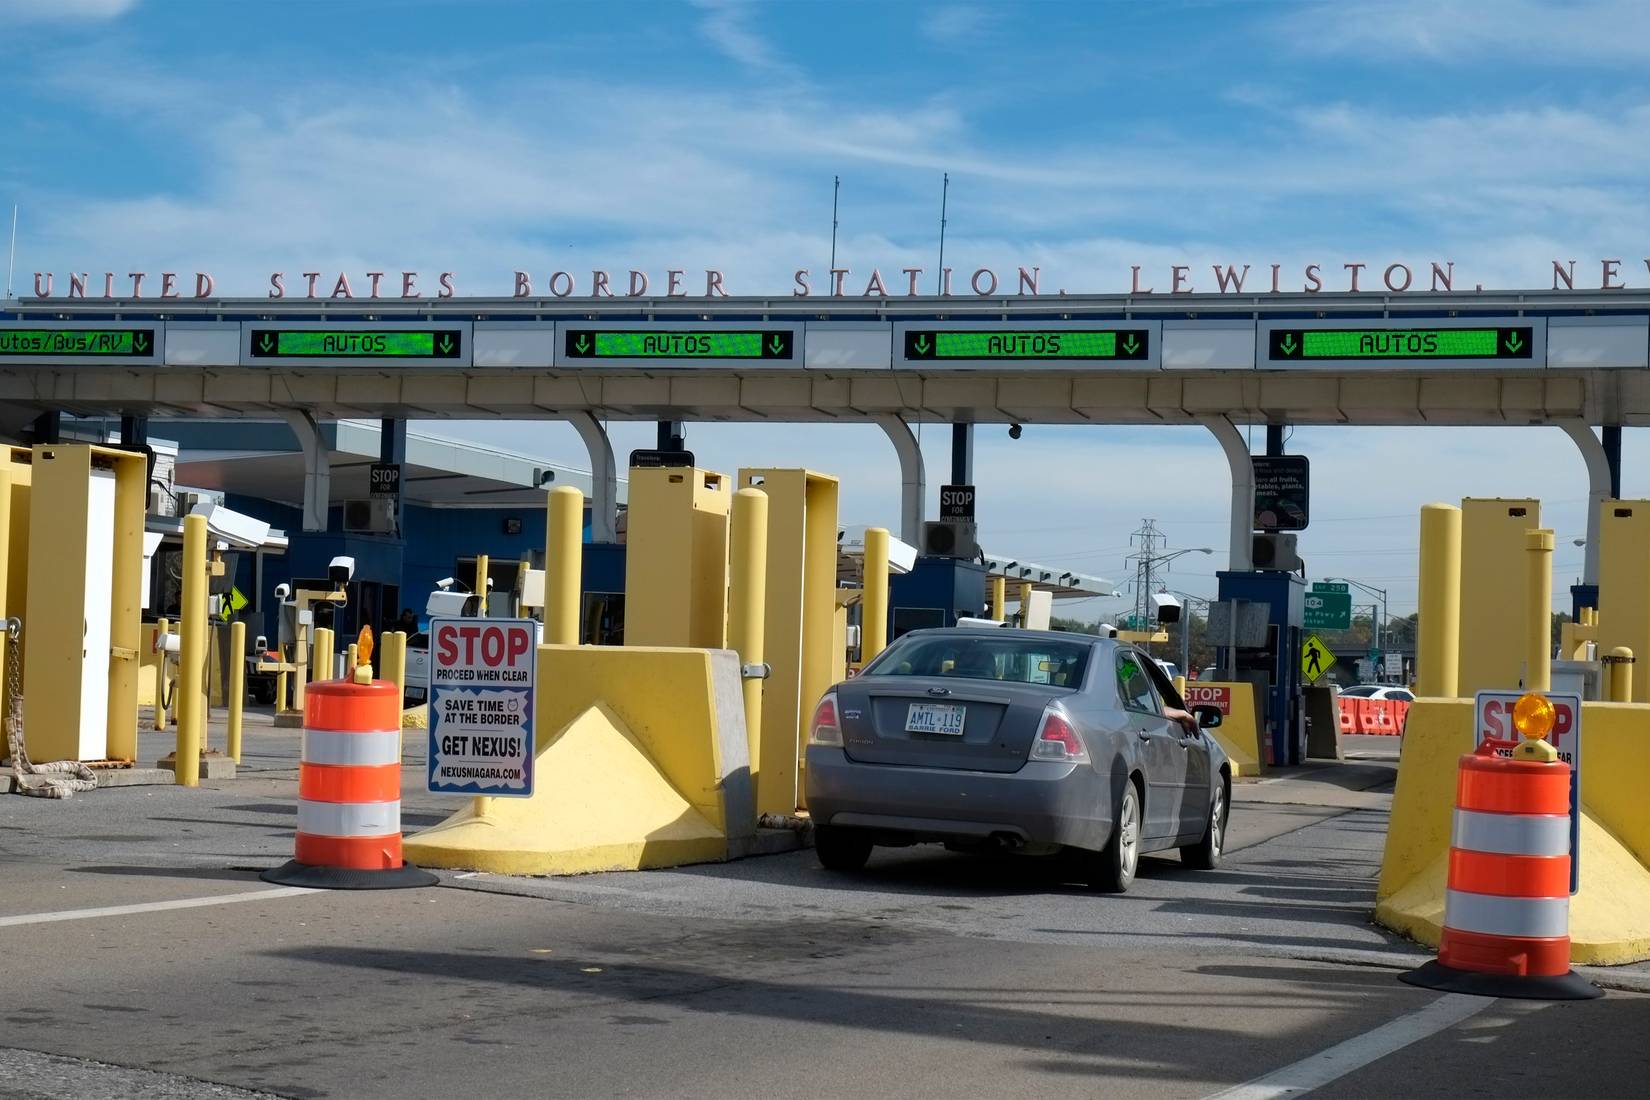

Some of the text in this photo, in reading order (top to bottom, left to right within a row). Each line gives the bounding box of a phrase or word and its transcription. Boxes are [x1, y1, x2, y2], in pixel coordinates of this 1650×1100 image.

[34, 272, 214, 298] UNITED
[269, 272, 456, 298] STATES
[514, 270, 729, 298] BORDER
[323, 335, 386, 352] AUTOS
[643, 335, 712, 354] AUTOS
[988, 335, 1061, 354] AUTOS
[1359, 333, 1438, 353] AUTOS
[372, 469, 399, 482] STOP
[942, 491, 973, 505] STOP
[437, 625, 529, 667] STOP
[437, 669, 528, 682] PROCEED WHEN CLEAR
[1184, 687, 1223, 701] STOP
[445, 699, 504, 712] SAVE TIME
[444, 713, 520, 726] AT THE BORDER
[910, 711, 962, 728] AMTL 119
[1483, 700, 1573, 747] STP
[908, 724, 961, 734] BARRIE FORD
[442, 735, 521, 758] GET NEXUS!
[441, 766, 521, 780] NEXUSNIAGARA.COM
